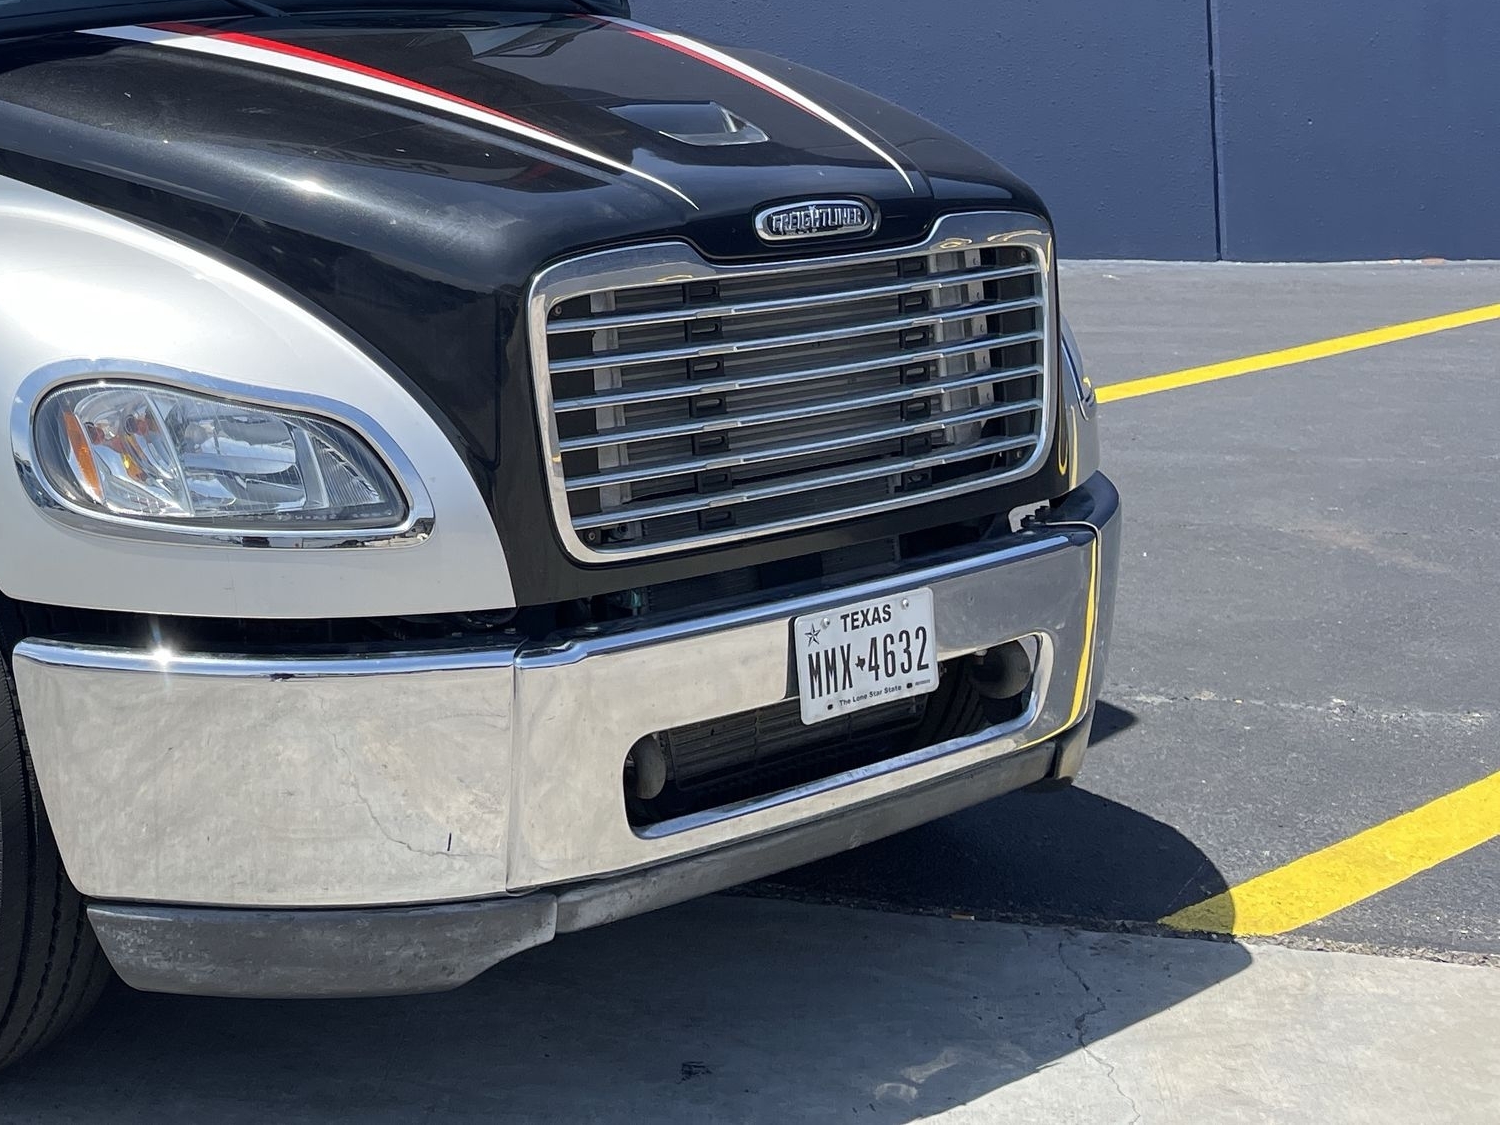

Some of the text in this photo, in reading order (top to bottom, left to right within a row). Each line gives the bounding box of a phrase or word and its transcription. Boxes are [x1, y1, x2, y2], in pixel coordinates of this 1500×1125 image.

[771, 204, 862, 236] FREIGHTLINER
[840, 604, 892, 633] TEXAS
[807, 625, 930, 700] MMX 4632
[840, 685, 902, 707] The Lone Star State
